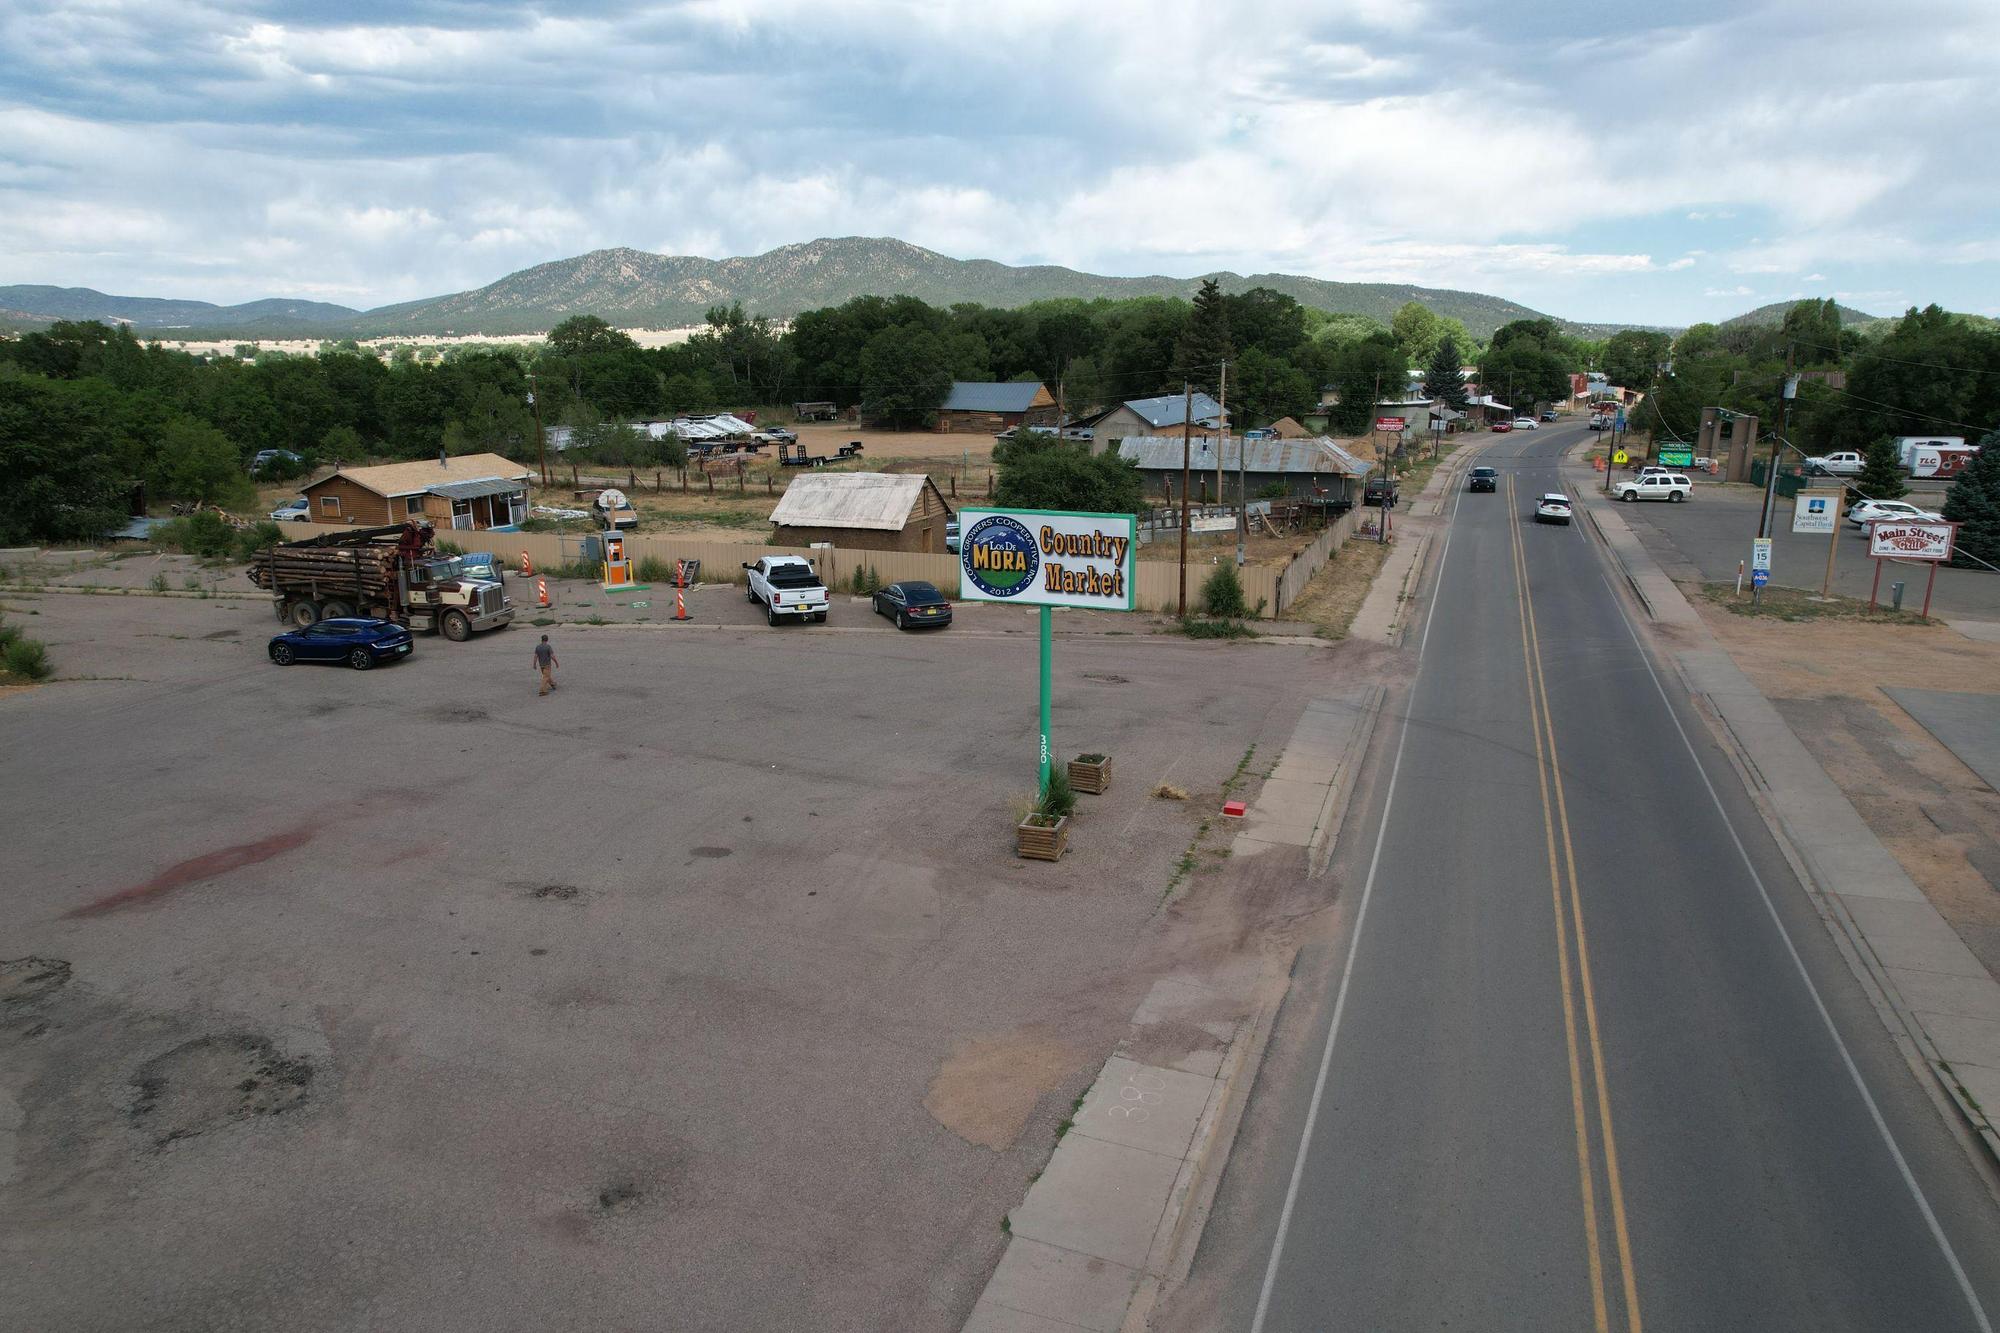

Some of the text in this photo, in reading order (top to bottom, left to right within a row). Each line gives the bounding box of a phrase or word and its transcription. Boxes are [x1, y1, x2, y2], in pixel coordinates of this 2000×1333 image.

[1040, 525, 1128, 566] Country
[1878, 527, 1945, 544] Main Street
[1898, 540, 1921, 550] Grill
[963, 552, 978, 581] LOCAL
[1021, 569, 1036, 585] INC.
[973, 543, 1027, 571] MORA
[989, 587, 1012, 595] 2012
[1045, 563, 1122, 595] Market
[1108, 1073, 1167, 1123] 380
